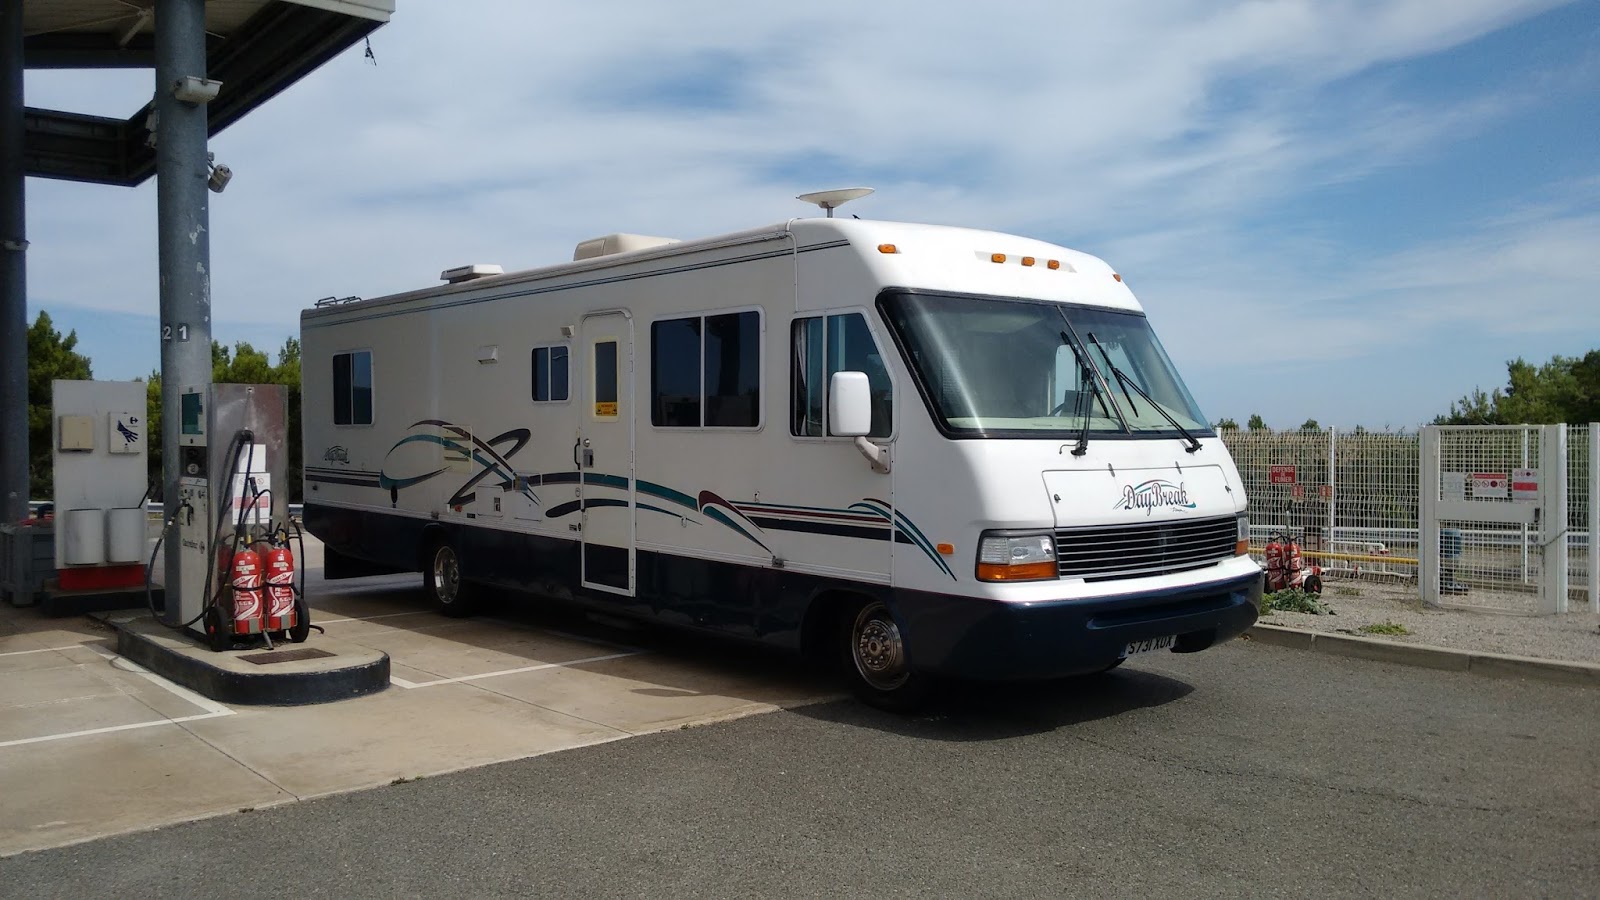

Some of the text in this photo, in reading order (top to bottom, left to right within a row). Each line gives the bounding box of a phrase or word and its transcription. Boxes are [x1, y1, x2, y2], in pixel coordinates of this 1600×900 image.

[163, 325, 187, 340] 2 1
[1123, 481, 1188, 516] DayBreak
